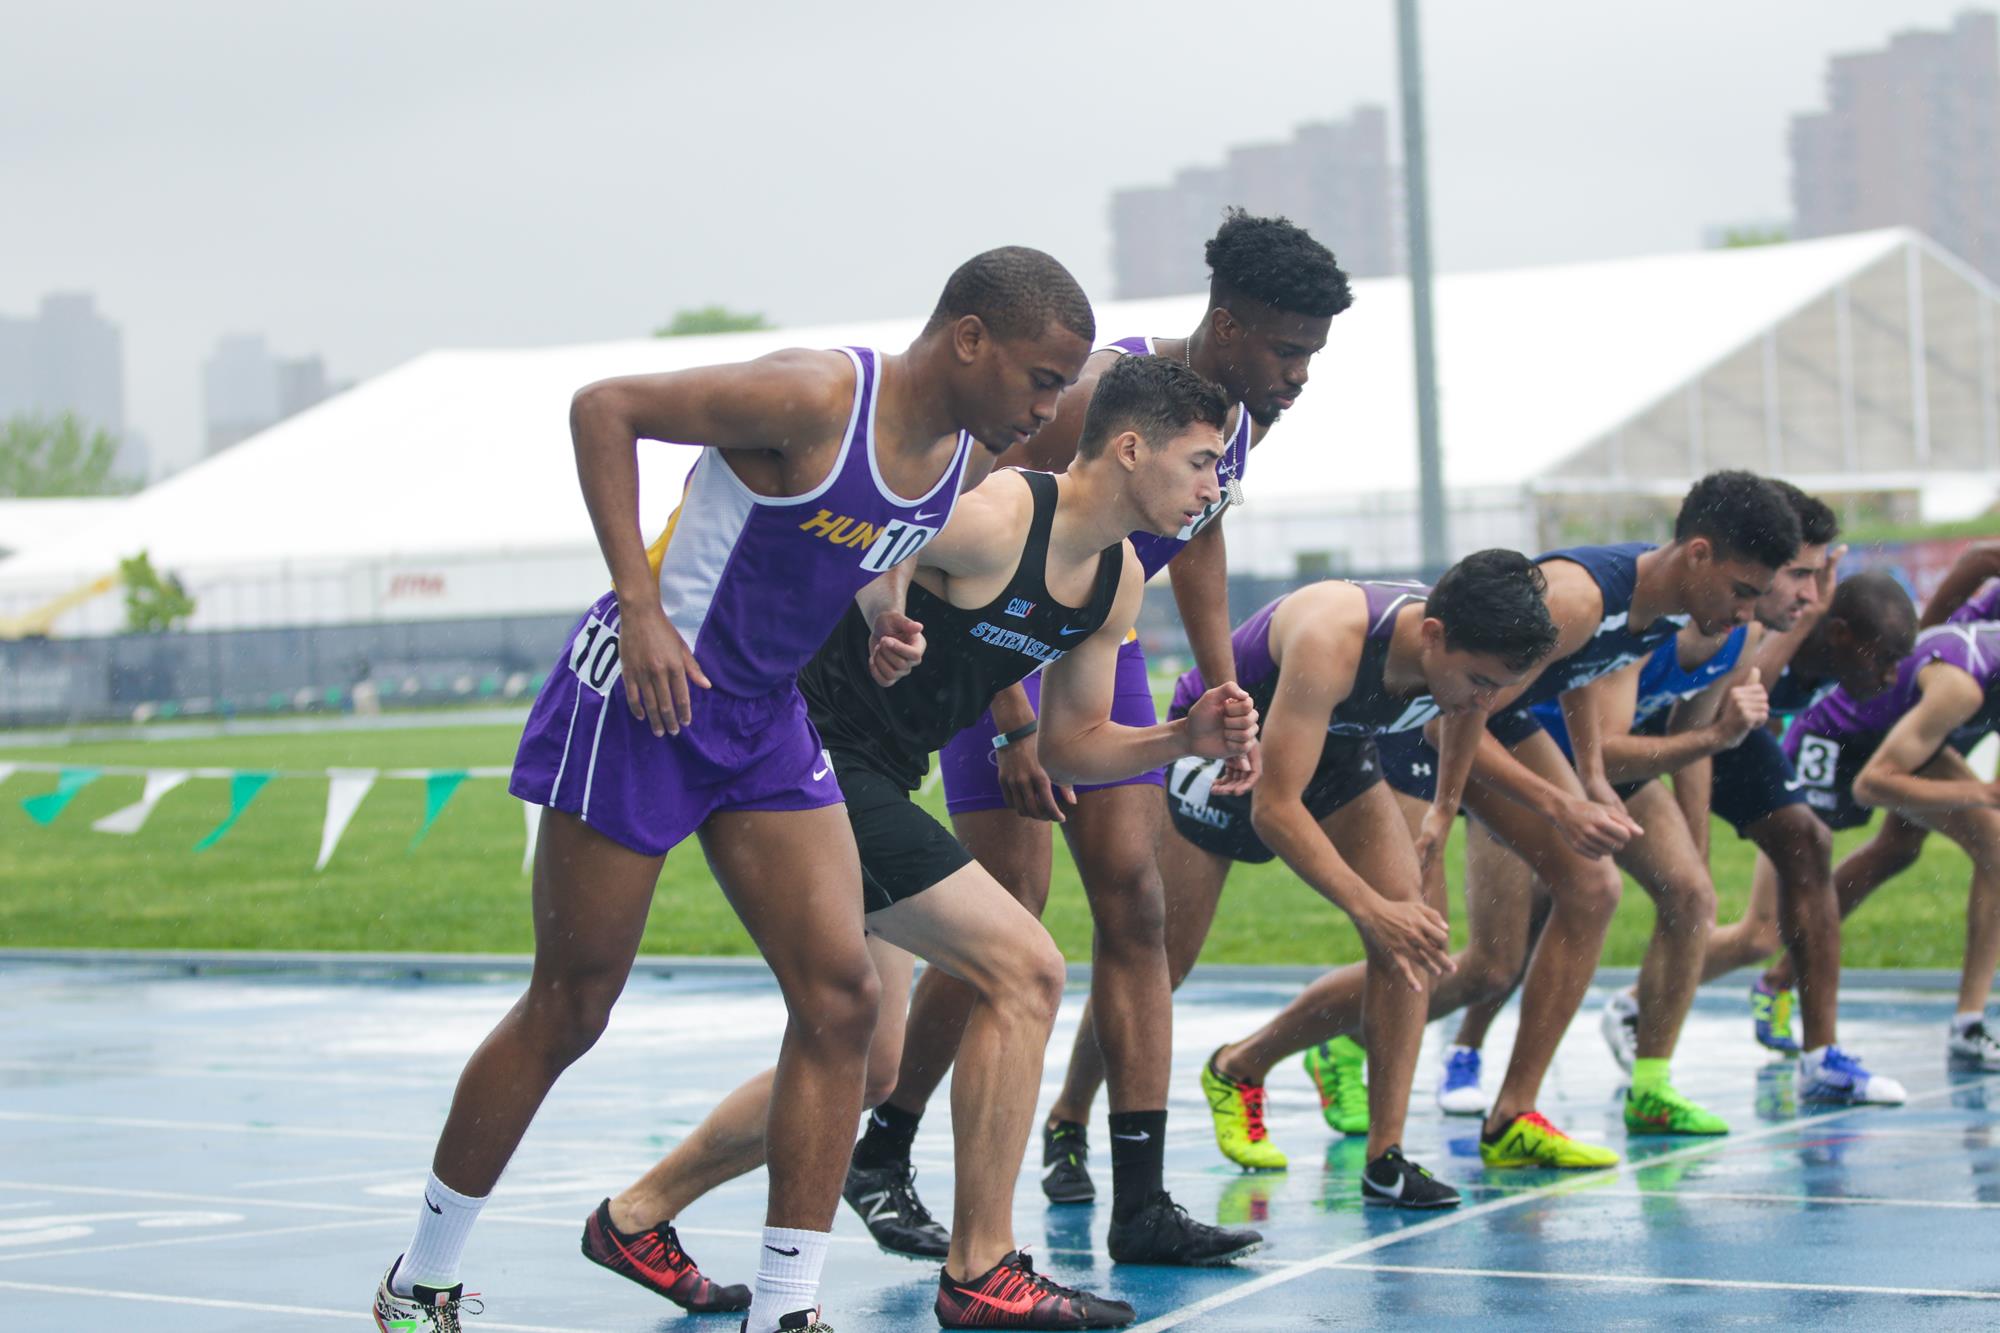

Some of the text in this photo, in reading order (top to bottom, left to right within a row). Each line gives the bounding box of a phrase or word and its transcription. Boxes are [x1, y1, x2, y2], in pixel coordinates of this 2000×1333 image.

[872, 525, 928, 569] 10
[1006, 597, 1037, 618] CUNY
[969, 621, 1029, 652] STATEN
[575, 623, 620, 688] 10
[1401, 698, 1435, 729] 7
[1804, 743, 1829, 781] 3
